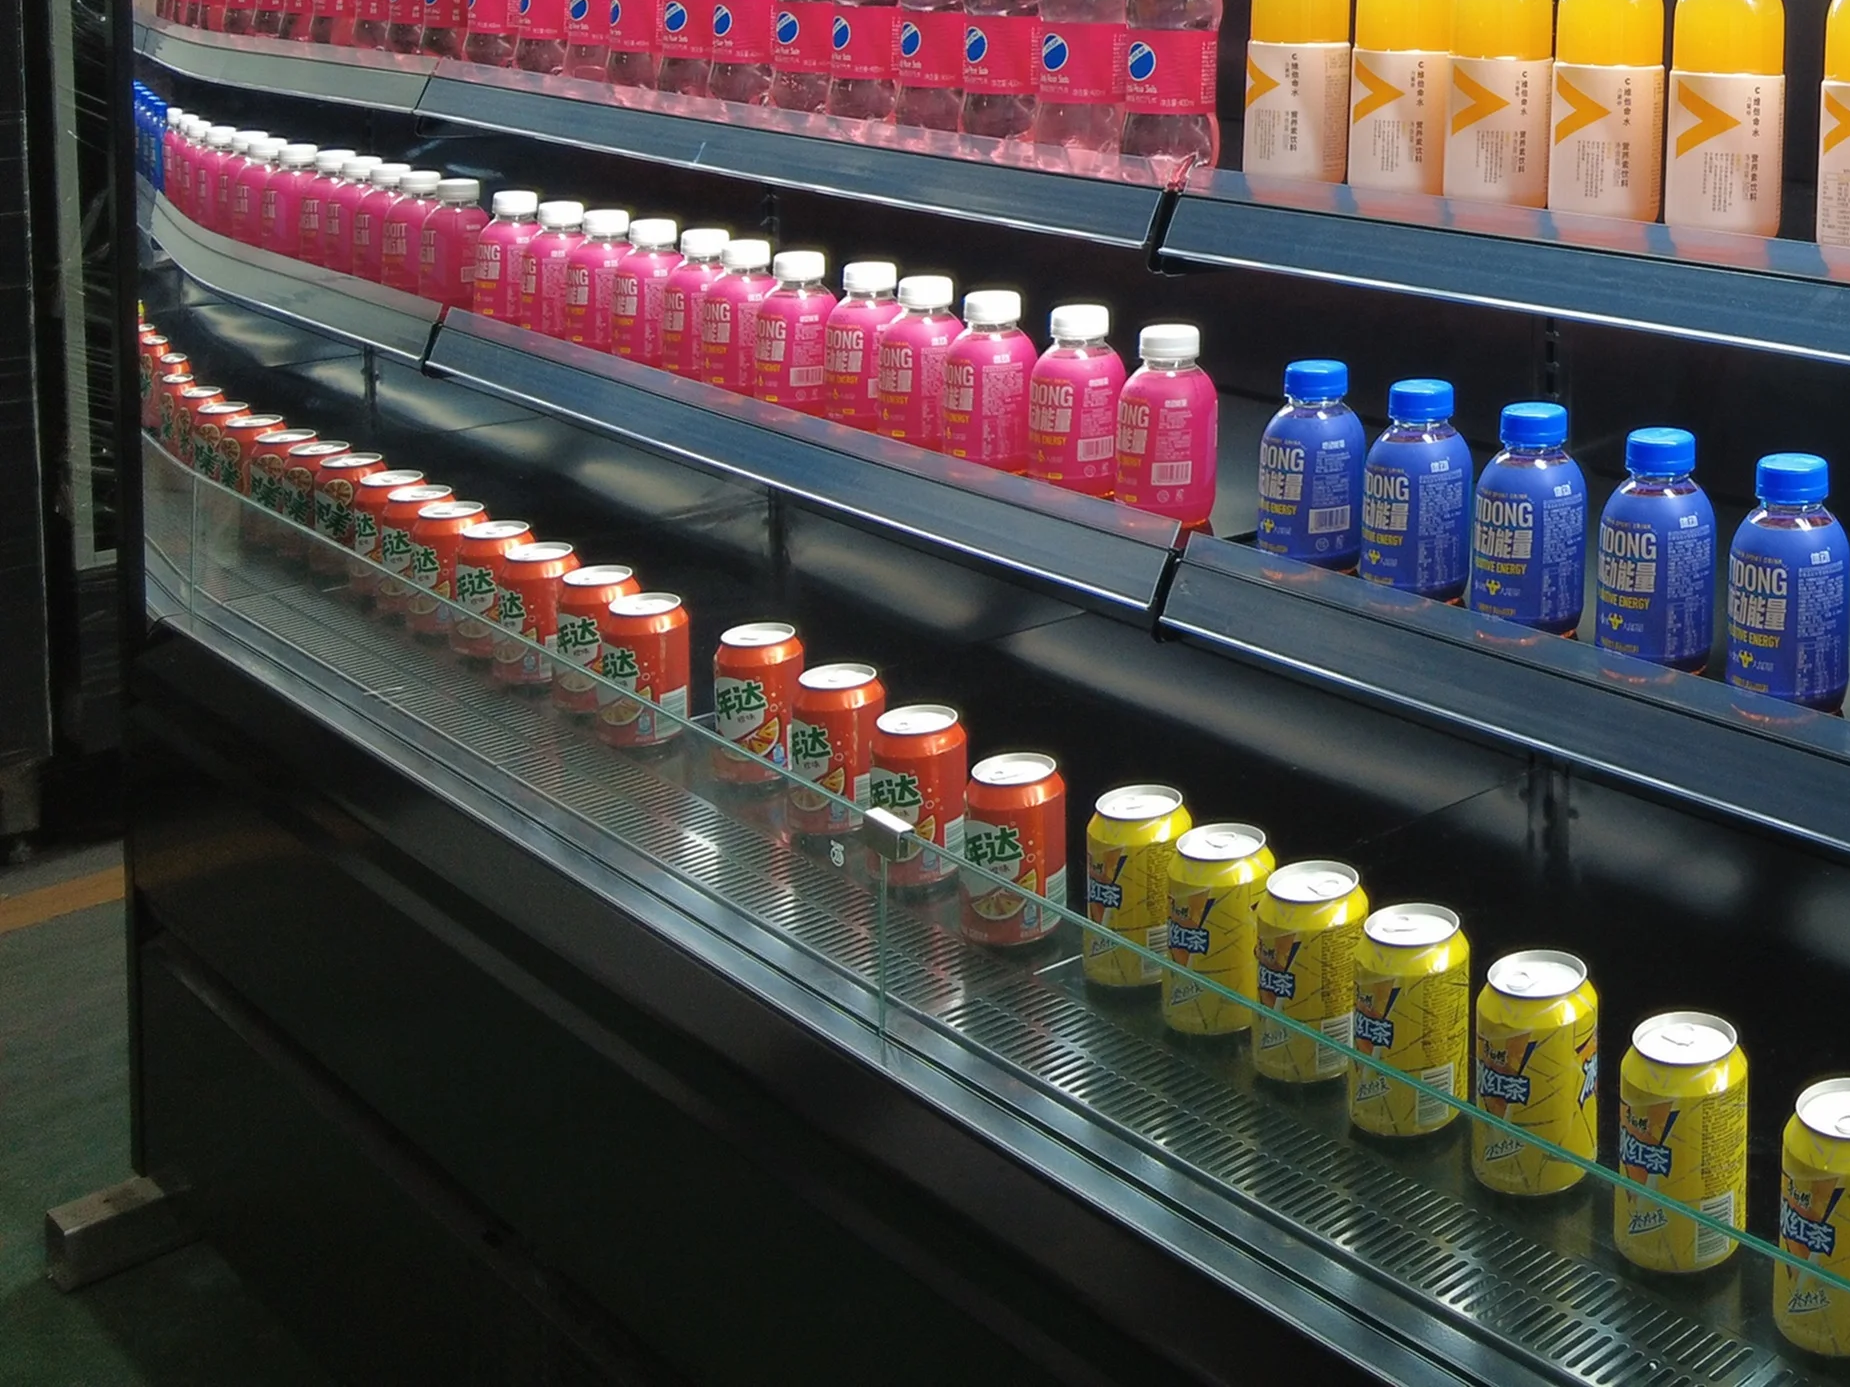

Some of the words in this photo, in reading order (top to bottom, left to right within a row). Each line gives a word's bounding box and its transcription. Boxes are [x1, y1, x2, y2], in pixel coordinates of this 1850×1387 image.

[1619, 595, 1650, 610] ENERGY
[1748, 631, 1780, 648] ENERGY
[1258, 966, 1296, 998] 红茶
[1356, 1013, 1394, 1049] 红茶
